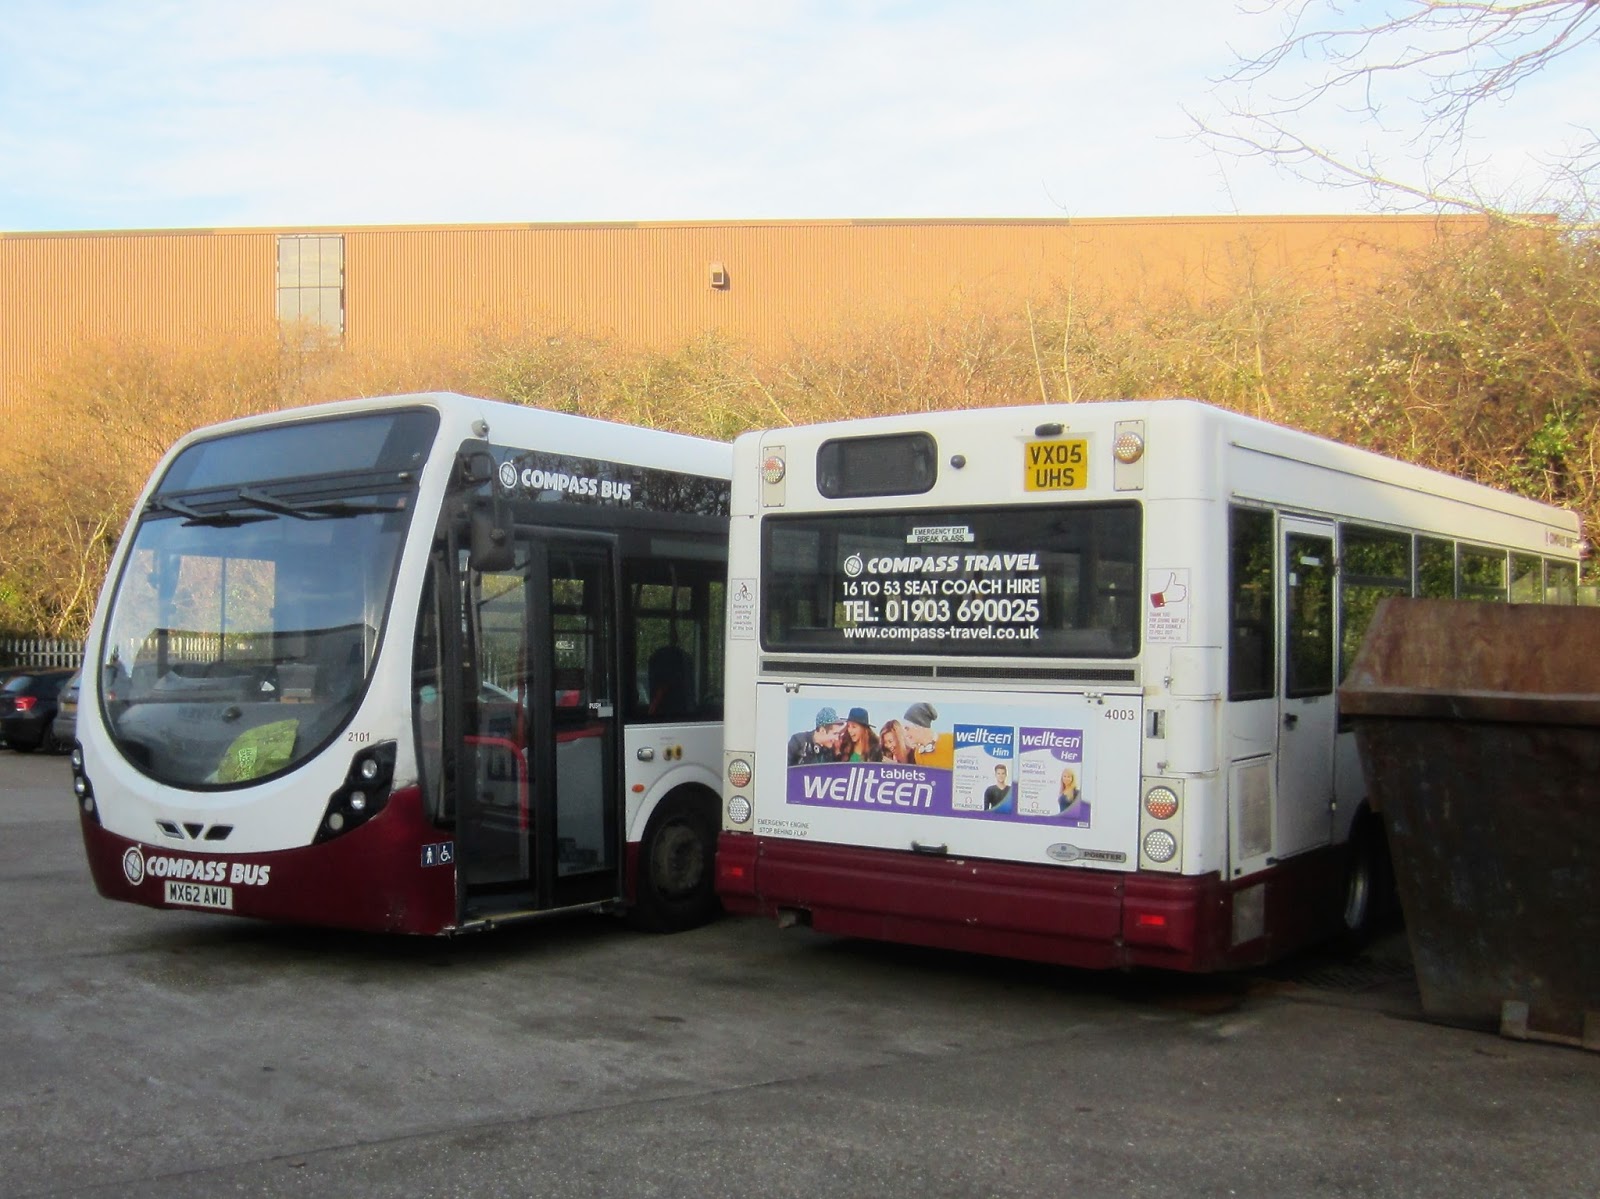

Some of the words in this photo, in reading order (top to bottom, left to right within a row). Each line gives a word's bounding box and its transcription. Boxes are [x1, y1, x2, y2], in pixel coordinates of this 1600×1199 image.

[1030, 443, 1082, 465] VX05
[521, 468, 599, 496] COMPASS
[601, 480, 632, 500] BUS
[1036, 467, 1075, 488] UHS
[914, 527, 951, 536] EMERGENCY
[952, 527, 966, 535] EXIT
[941, 534, 965, 542] GLASS
[867, 555, 959, 574] COMPASS
[964, 553, 1040, 573] TRAVEL
[843, 581, 858, 596] 16
[861, 581, 880, 596] TO
[883, 581, 901, 596] 53
[904, 580, 939, 595] SEAT
[941, 579, 1002, 595] COACH
[1006, 579, 1040, 594] HIRE
[843, 600, 879, 622] TEL:
[885, 600, 950, 622] 01903
[956, 599, 1040, 622] 690025
[843, 625, 1040, 642] www.compass-travel.co.uk
[1104, 709, 1135, 720] 4003
[348, 731, 370, 742] 2101
[956, 728, 1012, 745] wellteen
[1022, 731, 1080, 748] wellteen
[992, 747, 1010, 757] Him
[1060, 750, 1078, 760] Her
[880, 767, 926, 782] tablets
[803, 767, 933, 808] wellteen
[758, 819, 789, 827] EMERGENCY
[790, 821, 810, 829] ENGINE
[774, 828, 793, 836] BEHIND
[1084, 851, 1122, 861] POINTER
[146, 855, 228, 882] COMPASS
[230, 863, 271, 886] BUS
[170, 883, 200, 903] MX62
[203, 887, 227, 906] AWU
